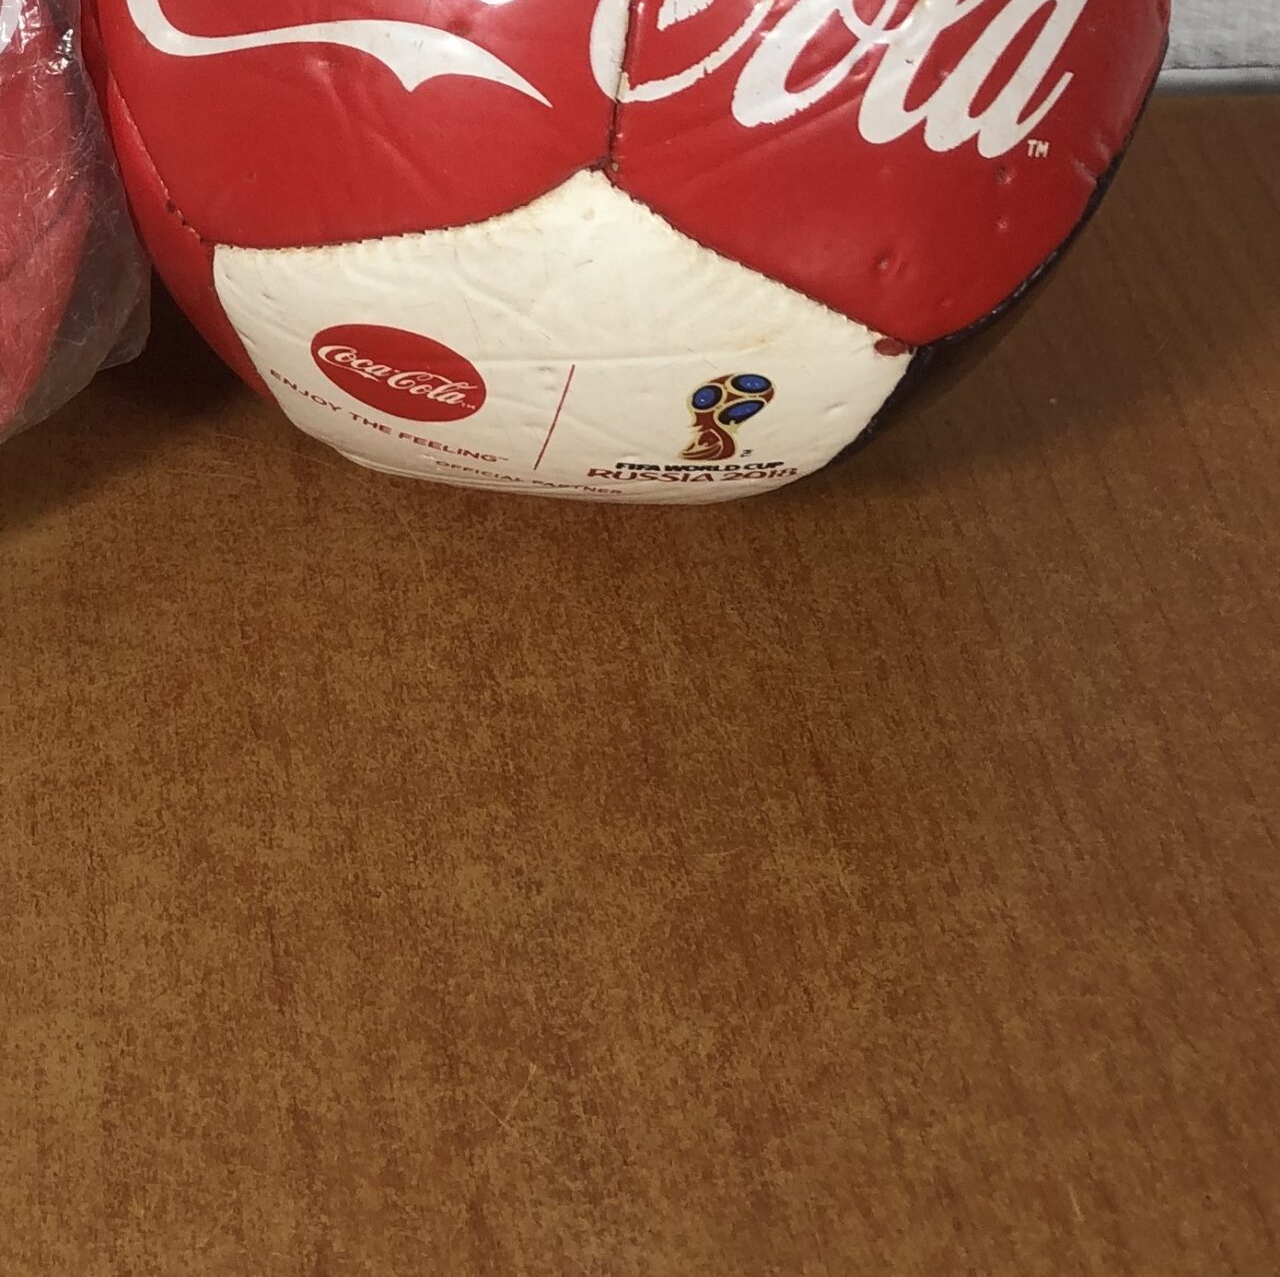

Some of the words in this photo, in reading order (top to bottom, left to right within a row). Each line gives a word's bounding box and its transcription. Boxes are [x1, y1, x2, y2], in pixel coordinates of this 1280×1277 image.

[318, 345, 478, 405] Coca-Cola
[270, 369, 342, 412] ENJOY
[348, 411, 392, 435] THE
[435, 460, 525, 482] OFFICIAL
[532, 480, 623, 494] PARTNER
[587, 468, 715, 482] RUSSIA
[719, 468, 798, 481] 2018
[616, 461, 661, 471] FIFA
[665, 463, 741, 472] WORLD
[743, 461, 786, 470] CUP
